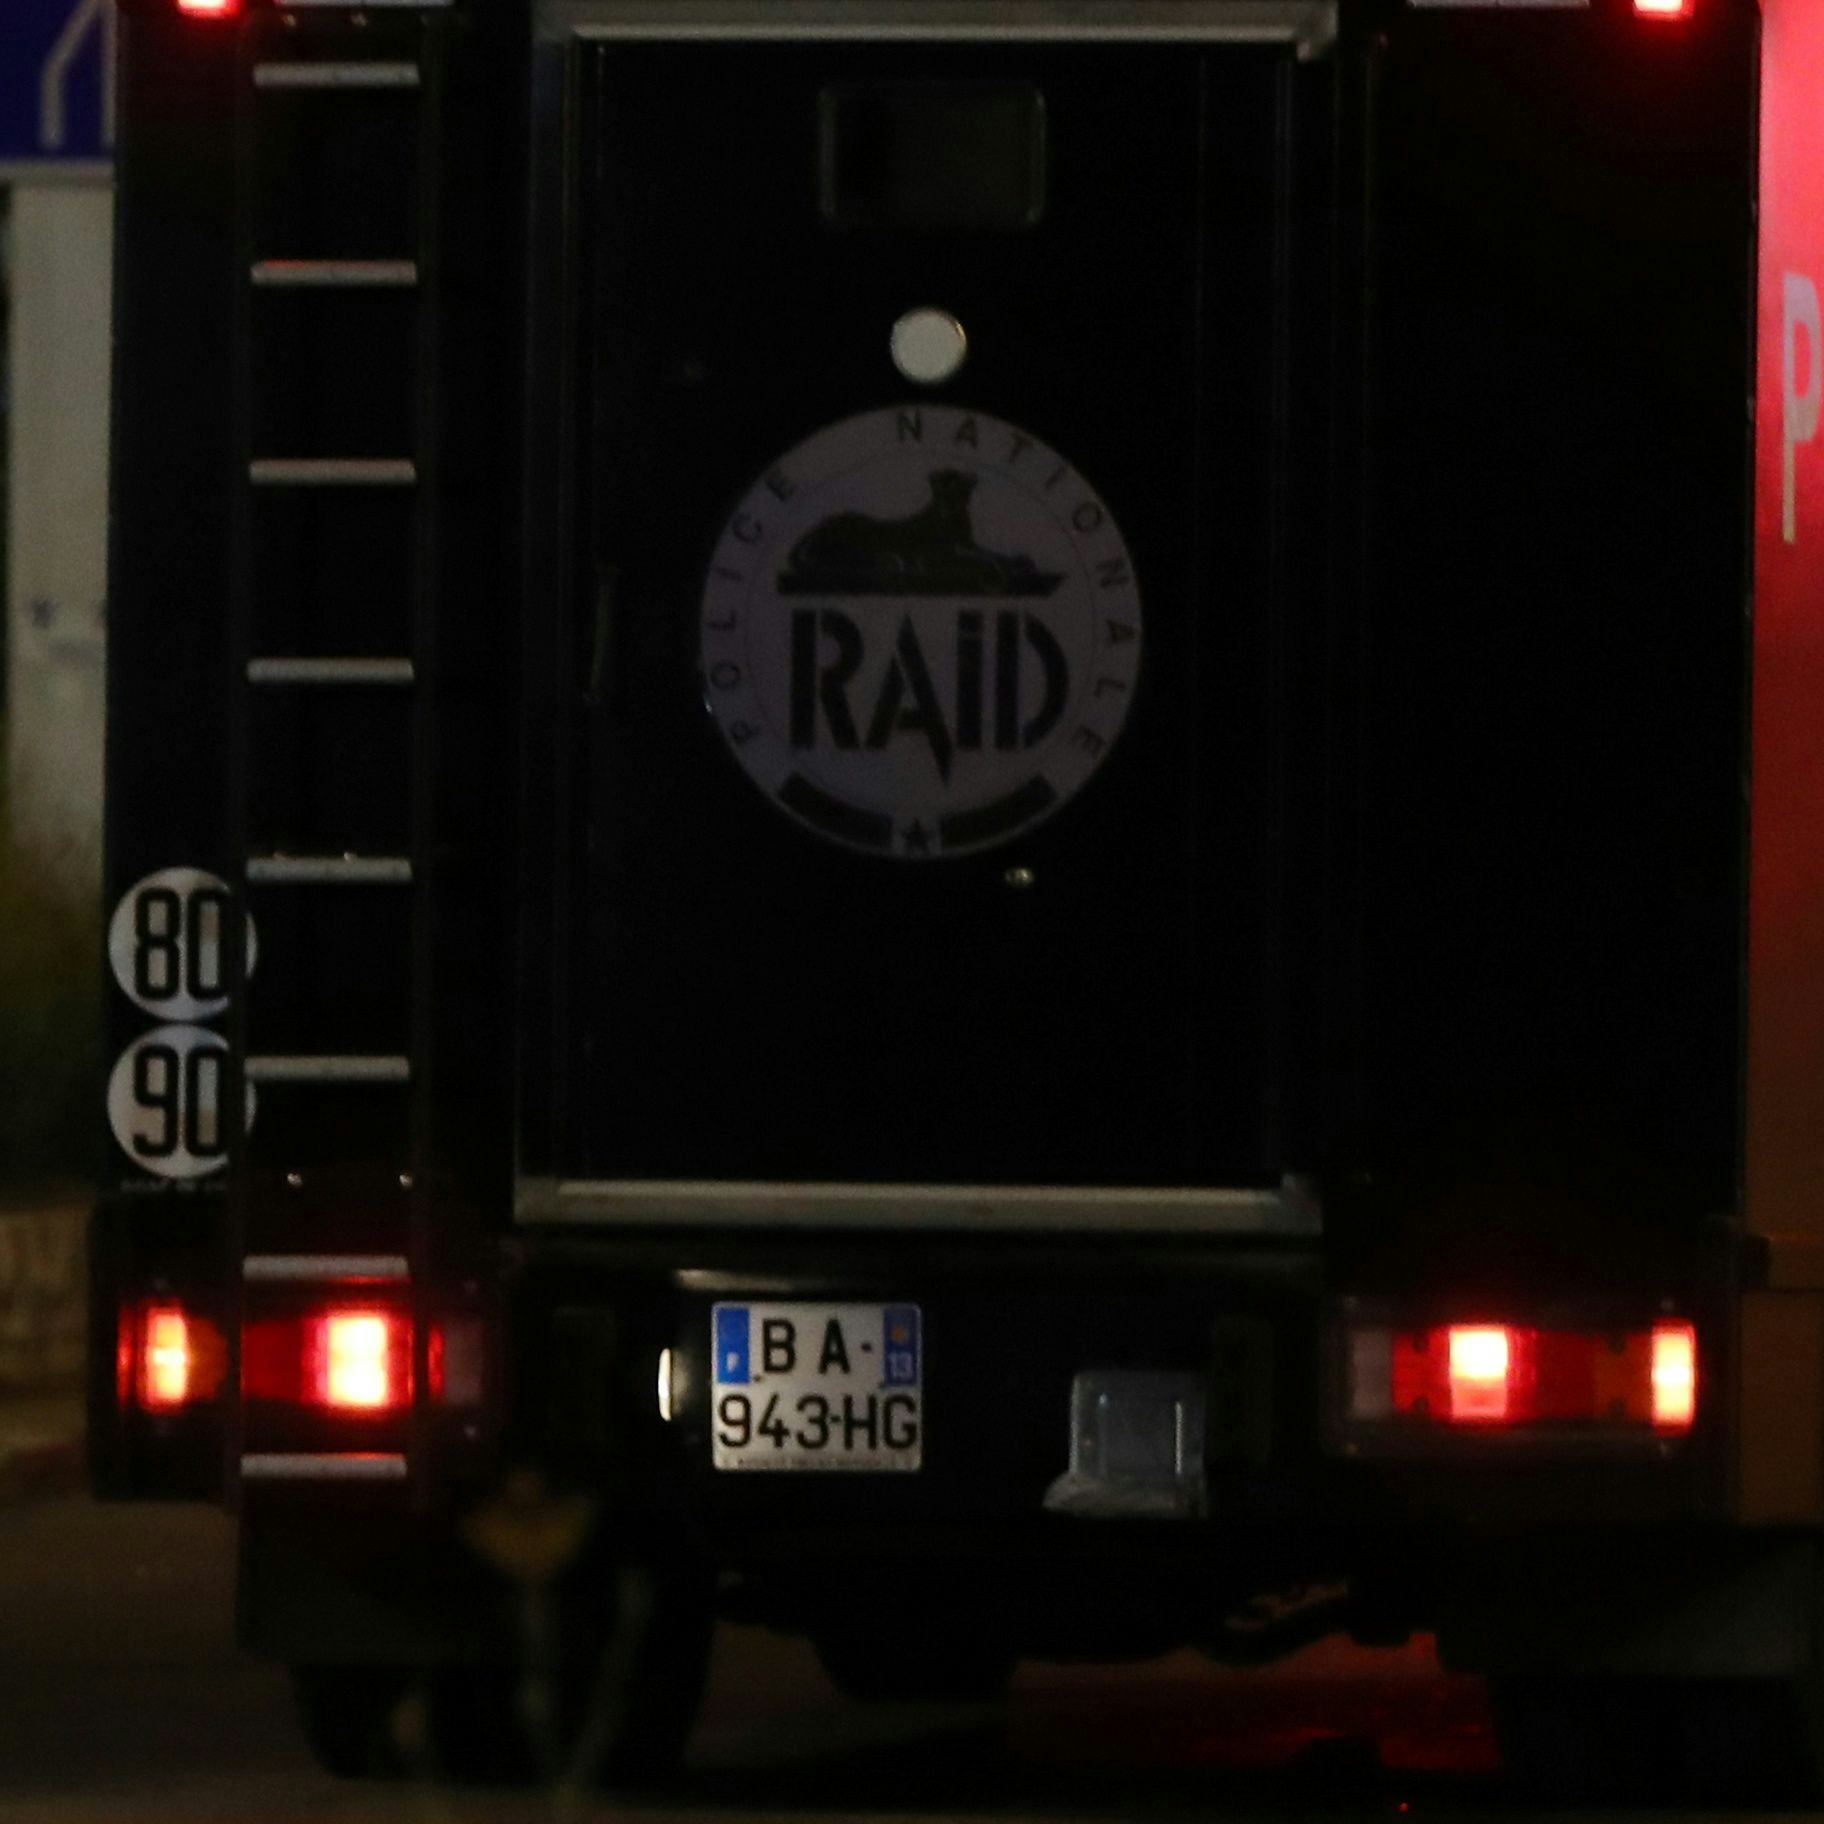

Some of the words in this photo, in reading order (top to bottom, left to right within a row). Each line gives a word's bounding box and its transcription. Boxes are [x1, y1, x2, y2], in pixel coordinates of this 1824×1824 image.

[707, 467, 794, 745] POLICE
[894, 409, 1138, 759] NATIONALE
[789, 608, 1070, 785] RAID
[134, 887, 229, 1000] 80
[132, 1044, 228, 1156] 90
[718, 1393, 919, 1451] 943-HG
